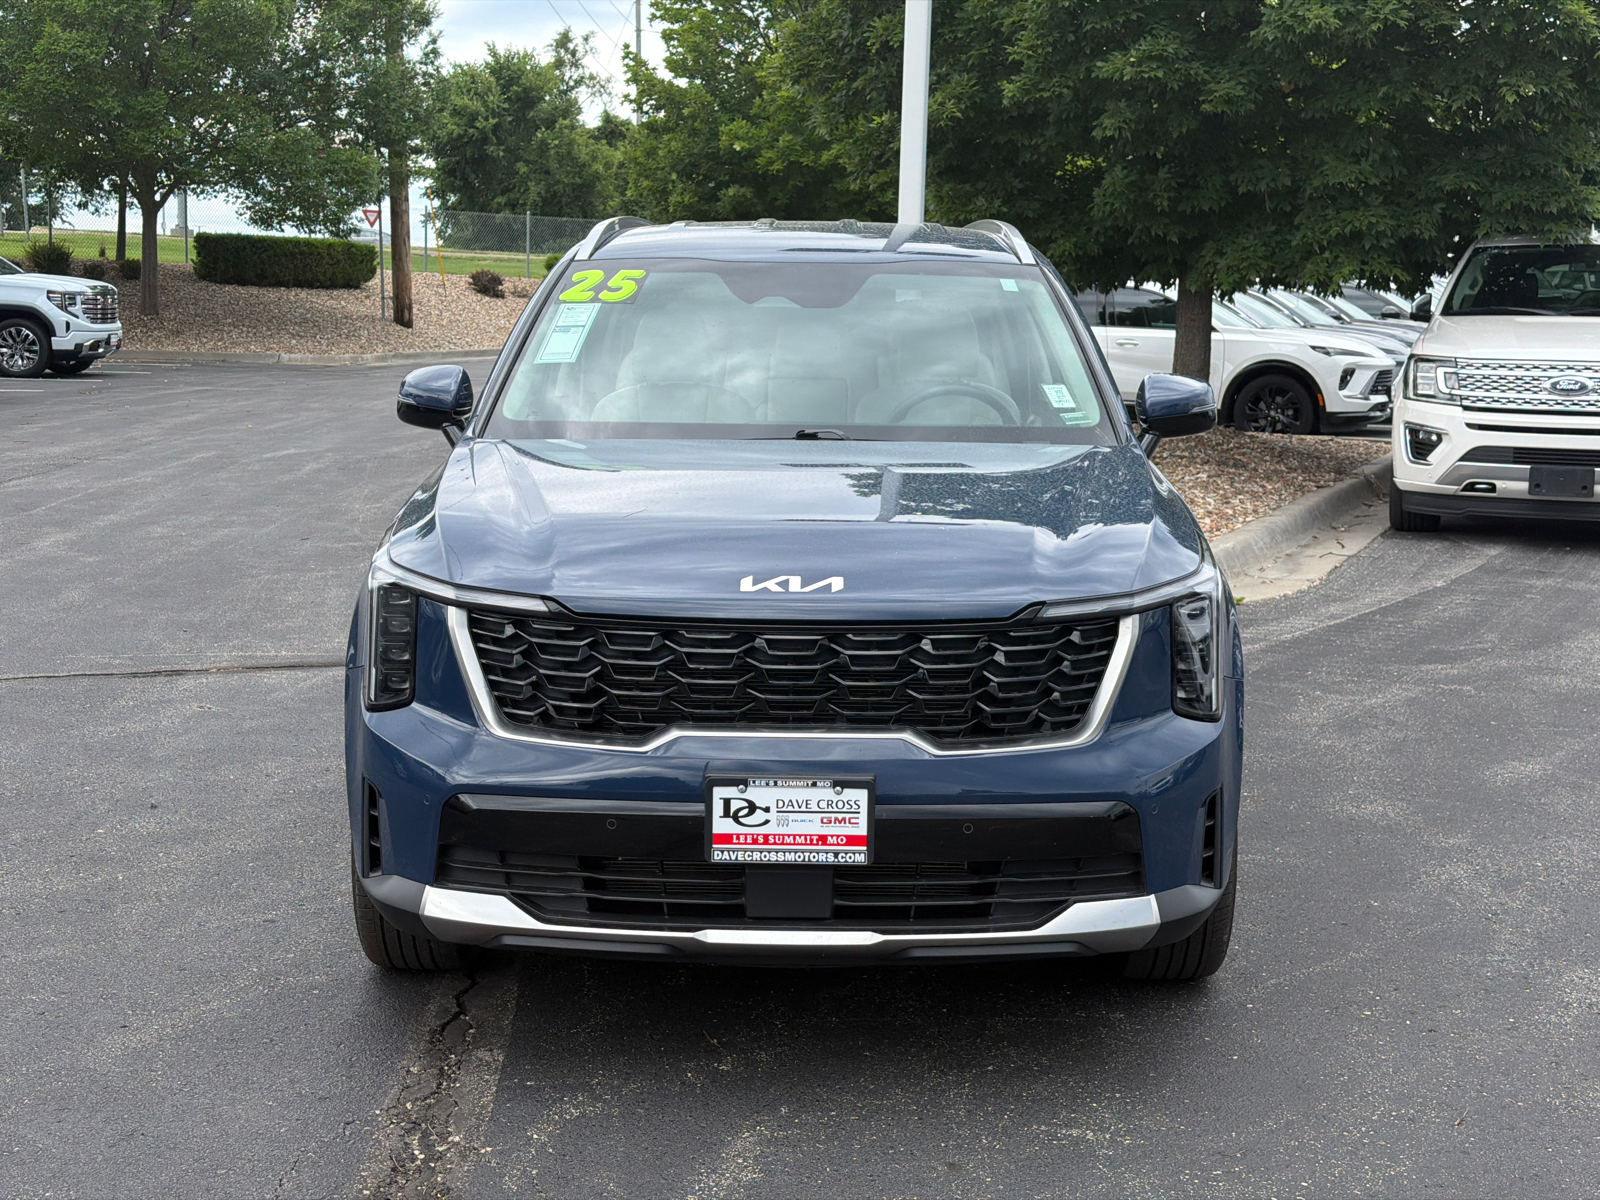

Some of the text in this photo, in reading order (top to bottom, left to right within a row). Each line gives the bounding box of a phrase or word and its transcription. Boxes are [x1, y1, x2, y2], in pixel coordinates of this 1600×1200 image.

[558, 269, 646, 303] 25
[1556, 380, 1582, 390] Ford
[739, 575, 844, 593] KIA
[776, 799, 861, 810] DAVE CROSS
[719, 797, 771, 828] DC
[820, 816, 860, 825] GMC
[732, 834, 847, 845] LEE'S SUMMIT, MO
[713, 850, 865, 863] DAVECROSSMOTORS.COM
